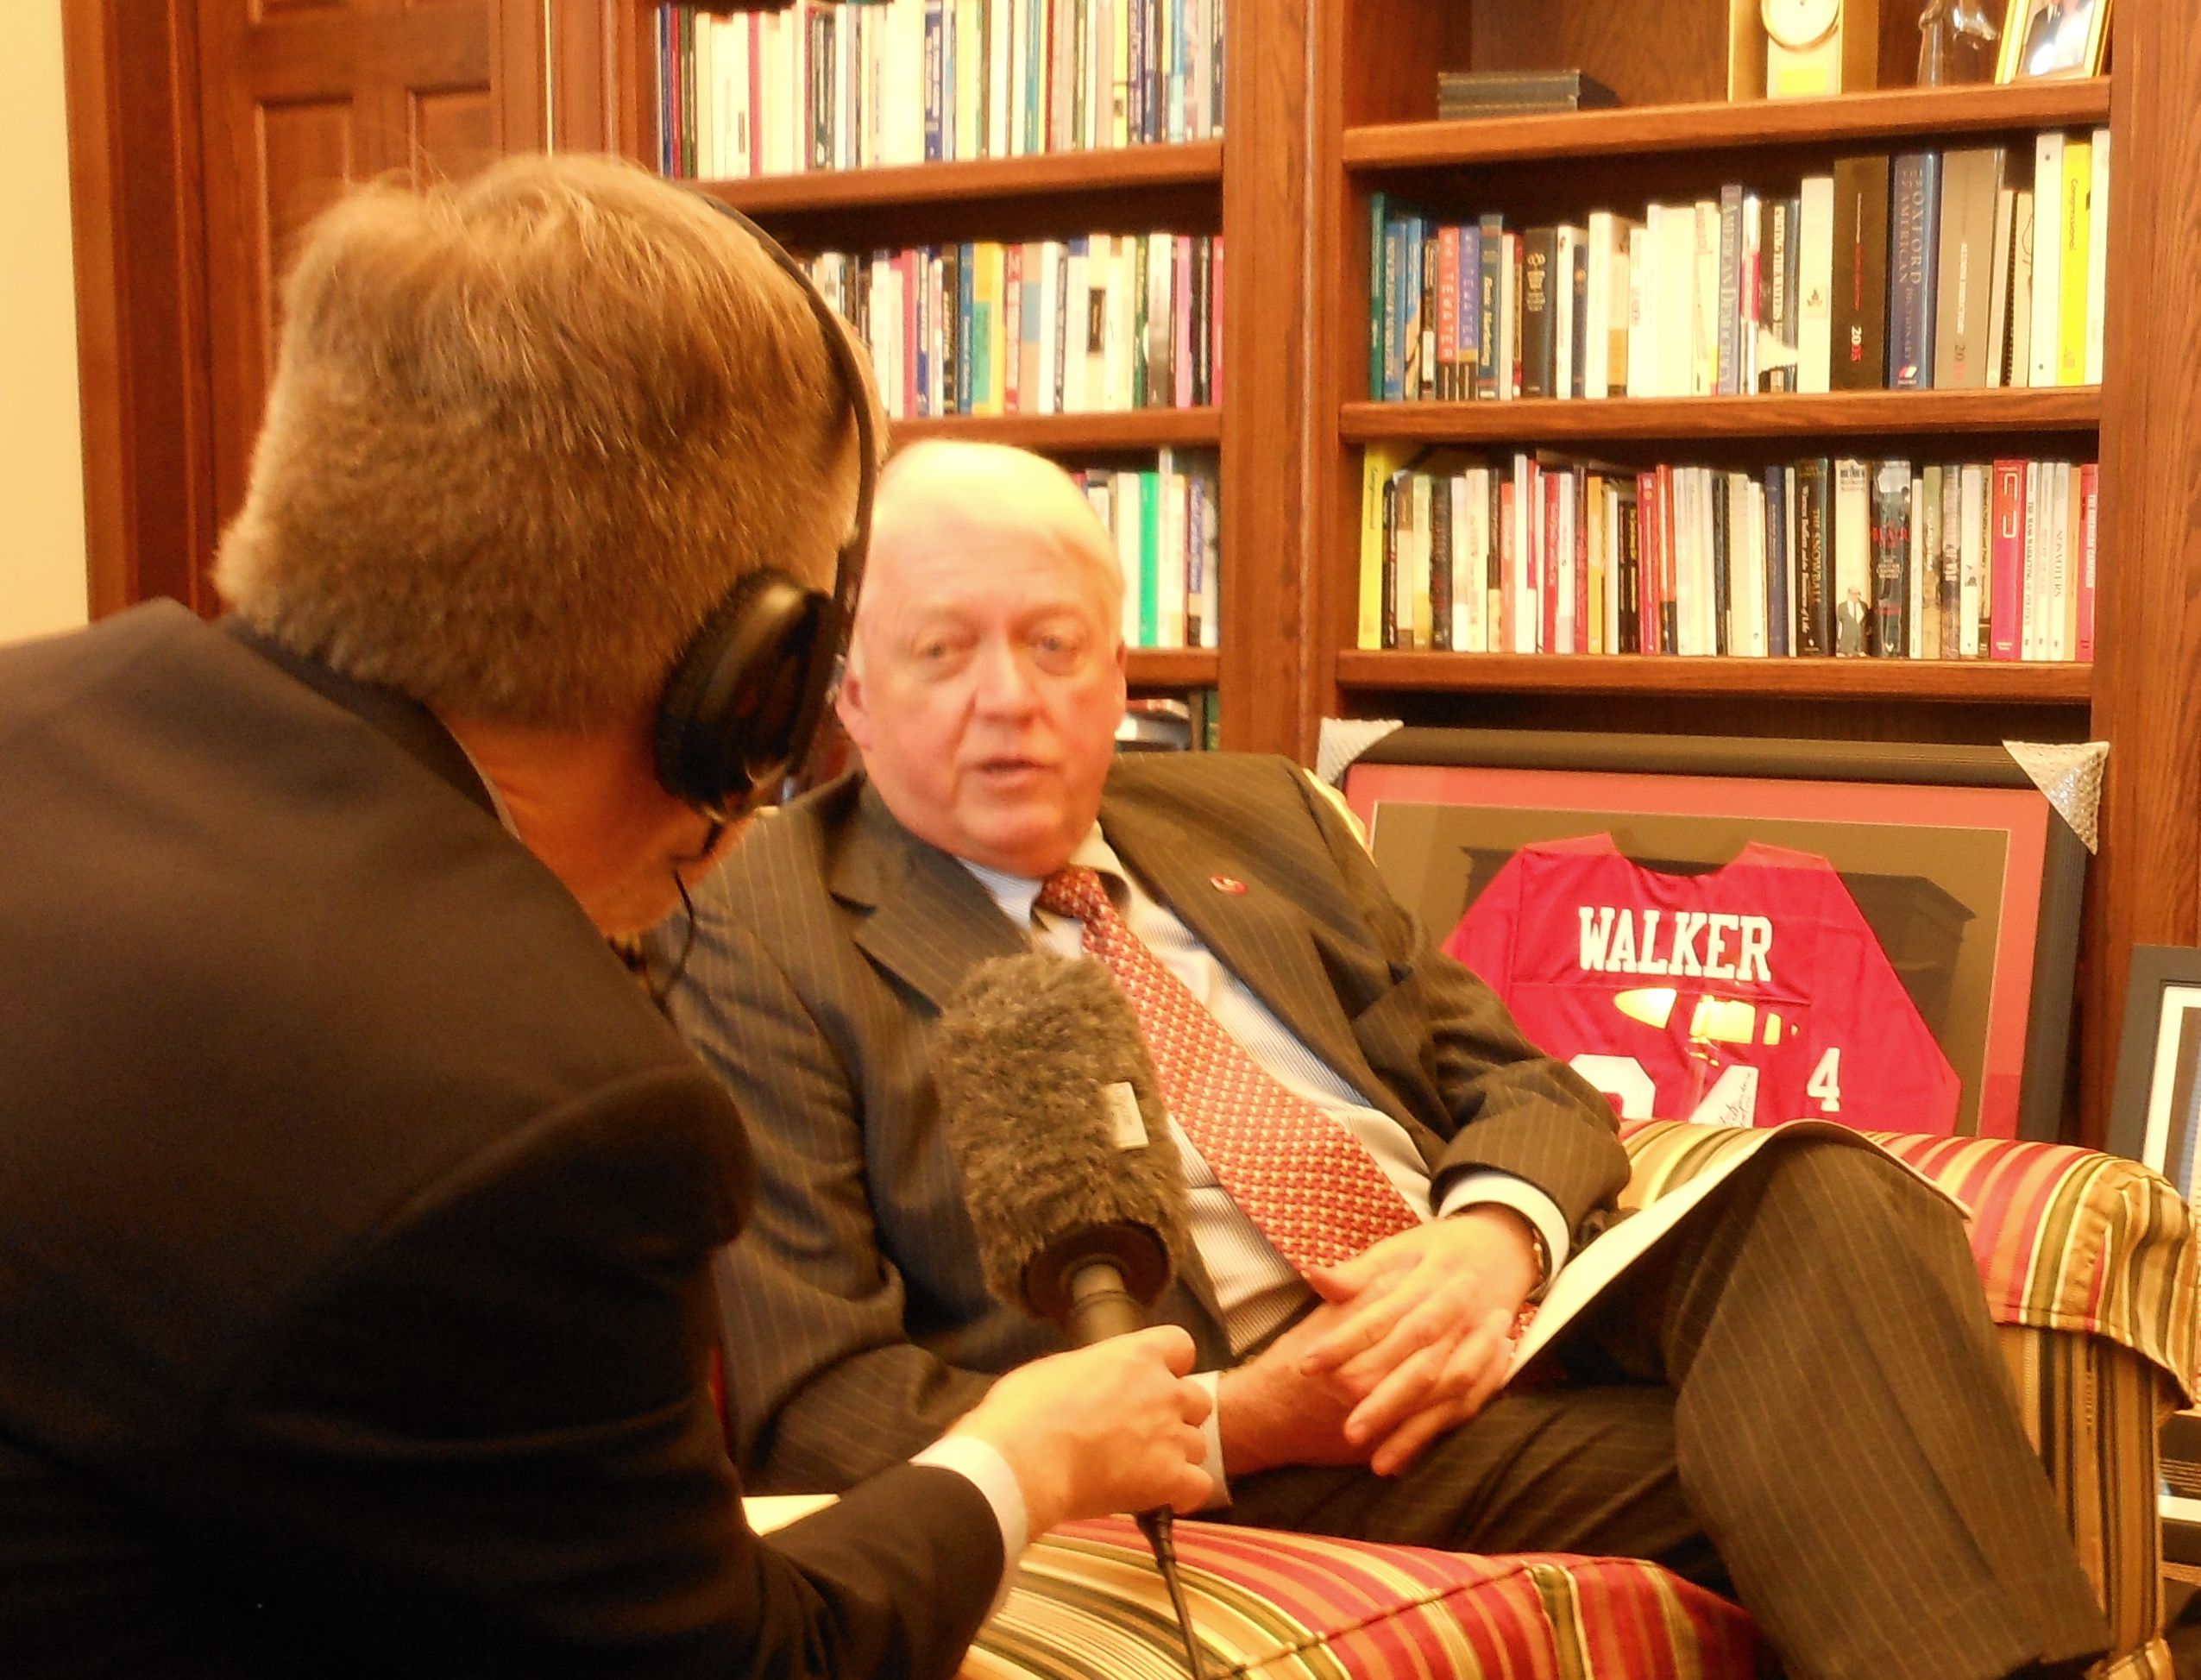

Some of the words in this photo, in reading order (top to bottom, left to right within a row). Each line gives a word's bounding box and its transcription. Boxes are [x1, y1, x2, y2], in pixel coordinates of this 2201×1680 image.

[1898, 192, 1909, 284] AMERICAN
[1910, 191, 1924, 285] OXFORD
[2067, 178, 2078, 250] Congressional
[1959, 242, 1968, 280] ALUMNI
[1903, 286, 1914, 361] DICTIONARY
[1955, 280, 1966, 335] DIRECTORY
[1851, 325, 1862, 362] 2005
[1812, 507, 1821, 528] THE
[1811, 531, 1821, 603] SNOWBALL
[2053, 530, 2064, 597] NONVOTERS
[1801, 617, 1809, 633] Life
[1578, 906, 1773, 982] WALKER
[1806, 1047, 1840, 1112] 4
